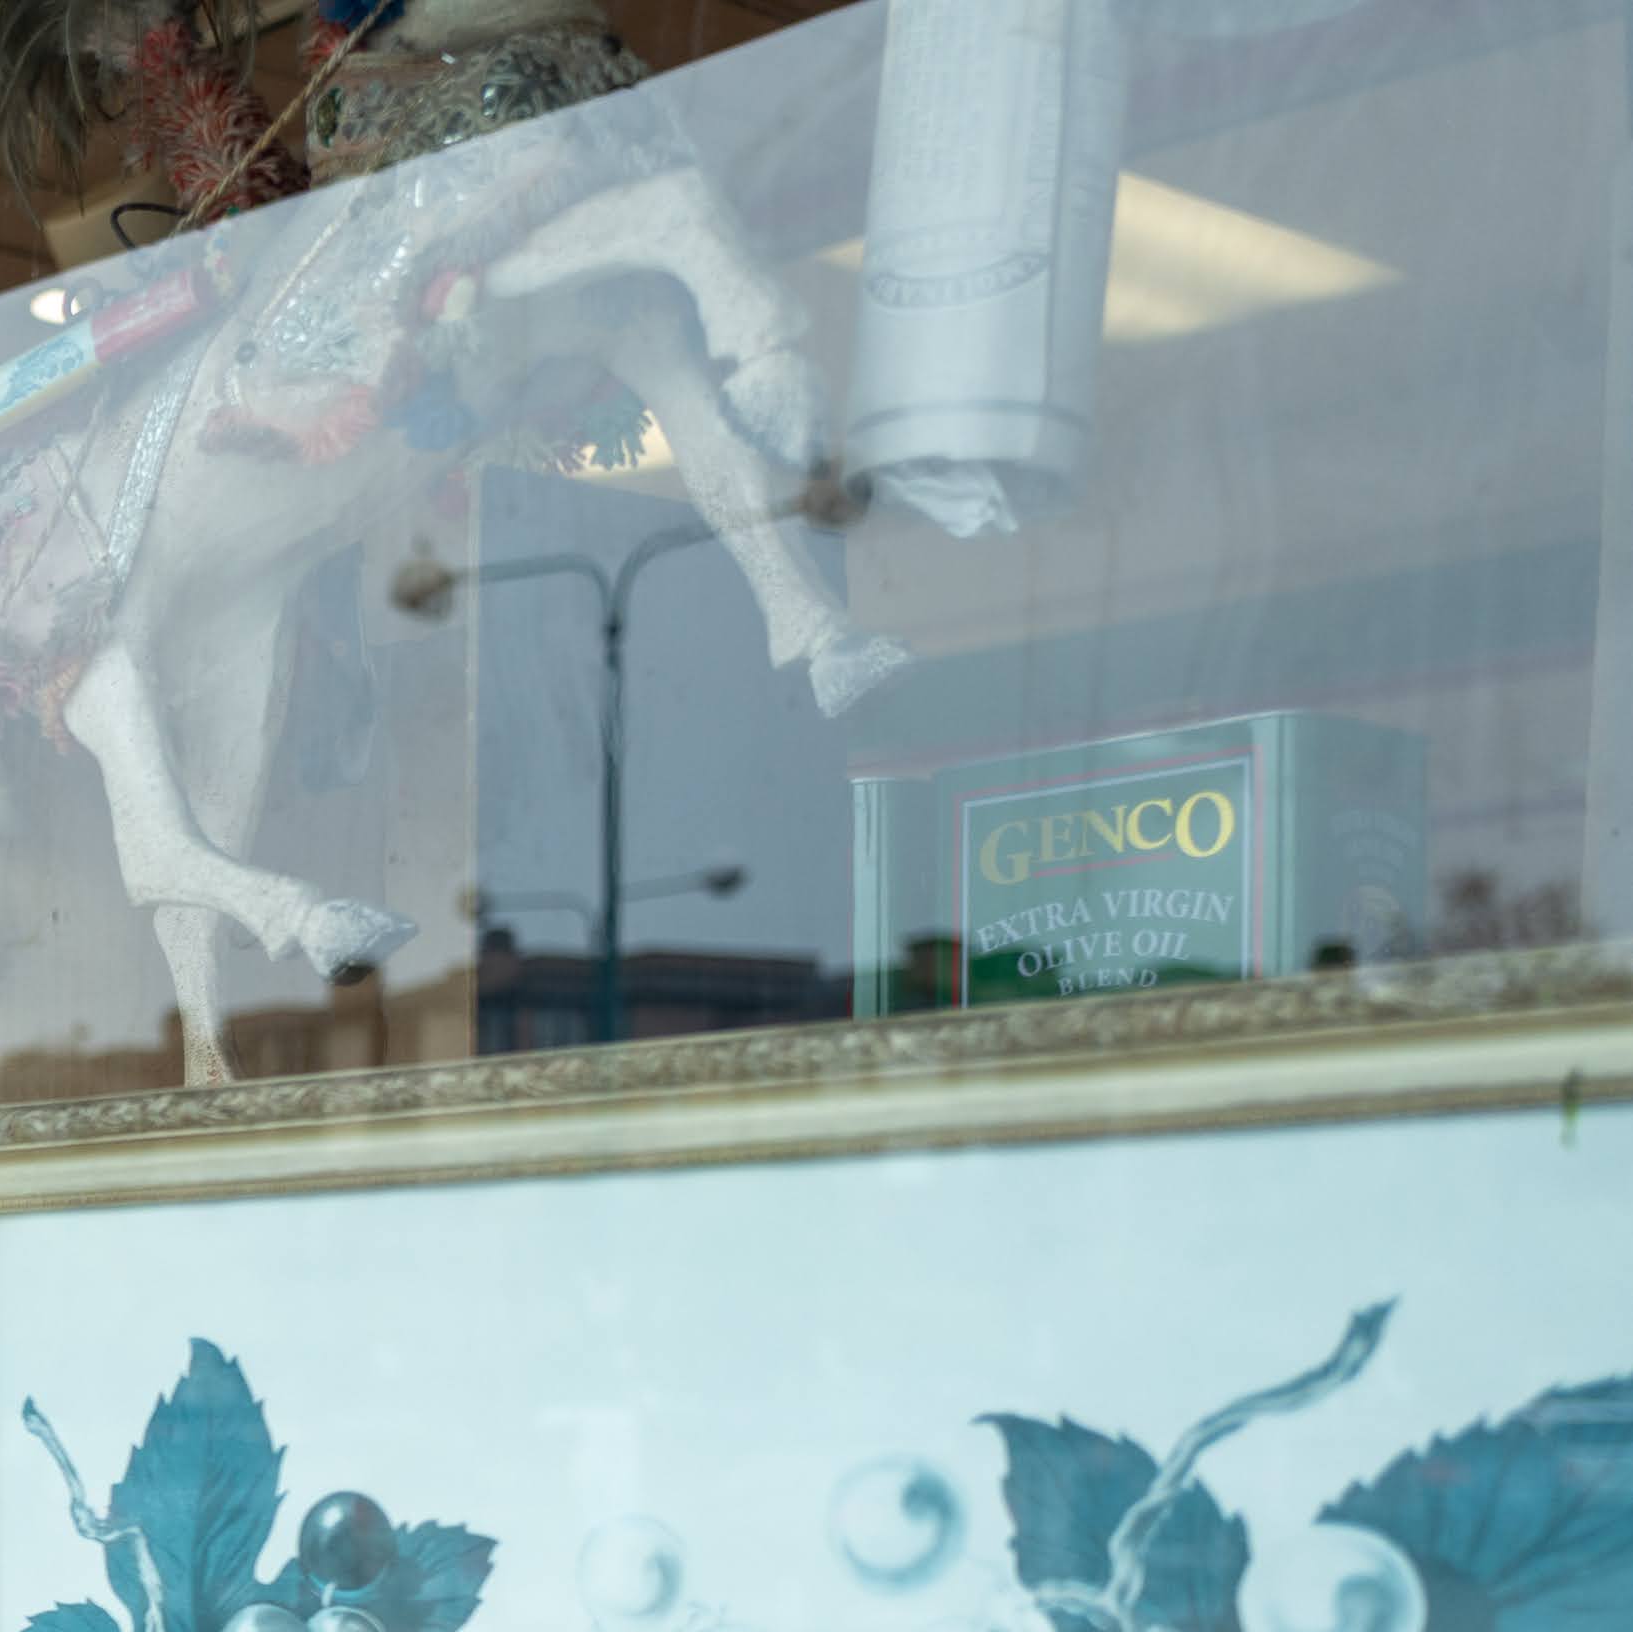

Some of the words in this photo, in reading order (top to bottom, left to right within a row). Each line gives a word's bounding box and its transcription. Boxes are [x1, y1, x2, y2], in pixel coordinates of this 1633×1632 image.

[978, 790, 1236, 885] GENCO
[976, 895, 1093, 955] EXTRA
[1101, 888, 1235, 926] VIRGIN
[1016, 930, 1123, 978] OLIVE
[1130, 929, 1192, 962] OIL
[1059, 966, 1159, 997] BLEND
